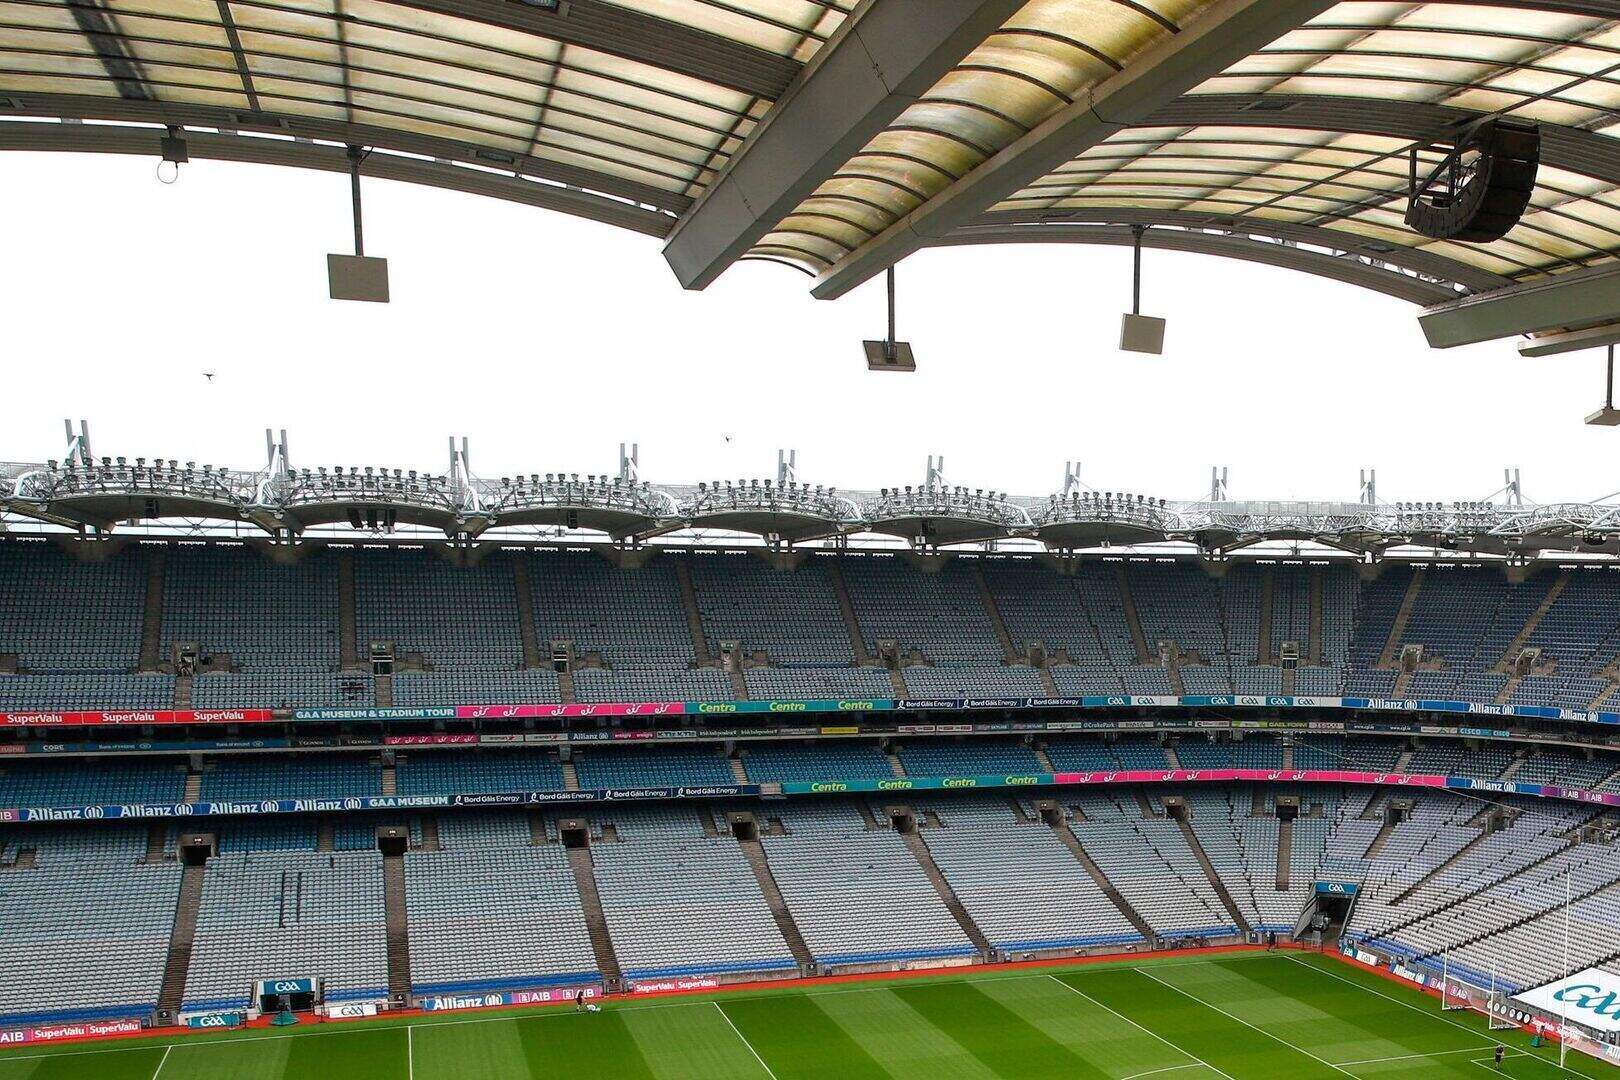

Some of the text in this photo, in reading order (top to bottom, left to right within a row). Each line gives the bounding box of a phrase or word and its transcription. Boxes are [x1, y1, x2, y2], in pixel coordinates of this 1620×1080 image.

[838, 701, 873, 710] Centra
[934, 700, 954, 709] Energy
[998, 699, 1018, 708] Energy
[1060, 698, 1079, 707] Energy
[1108, 697, 1124, 705] GAA
[1211, 697, 1228, 705] GAA
[1270, 697, 1288, 705] GAA
[1368, 699, 1402, 709] Allianz
[699, 703, 736, 712] Centra
[770, 702, 805, 712] Centra
[1469, 704, 1500, 714] Allianz
[102, 713, 155, 722] SuperValu
[194, 711, 244, 720] SuperValu
[322, 710, 367, 718] MUSEUM
[369, 710, 377, 718] &
[378, 709, 424, 718] STADIUM
[425, 708, 454, 717] TOUR
[1559, 709, 1586, 721] Allianz
[7, 714, 62, 723] SuperValu
[878, 780, 912, 790] Centra
[943, 778, 976, 787] Centra
[1005, 776, 1038, 785] Centra
[1471, 780, 1502, 791] Allianz
[716, 787, 738, 795] Energy
[812, 782, 846, 792] Centra
[496, 795, 519, 803] Energy
[571, 792, 595, 800] Energy
[645, 790, 668, 798] Energy
[1568, 791, 1579, 799] AIB
[1591, 794, 1602, 802] AIB
[294, 800, 341, 811] Allianz
[370, 796, 448, 807] GAA MUSEUM
[120, 807, 171, 818] Allianz
[209, 804, 258, 815] Allianz
[0, 812, 12, 820] IB
[27, 809, 81, 821] Allianz
[1328, 884, 1345, 892] GAA
[1393, 966, 1416, 981] Allianz
[274, 981, 300, 992] GAA
[636, 982, 675, 993] SuperValu
[678, 978, 716, 989] SuperValu
[532, 991, 550, 1002] AIB
[433, 997, 482, 1010] Allianz
[340, 1006, 365, 1016] GAA
[200, 1016, 225, 1026] GAA
[34, 1026, 84, 1039] SuperValu
[90, 1023, 138, 1034] SuperValu
[0, 1032, 24, 1042] AIB
